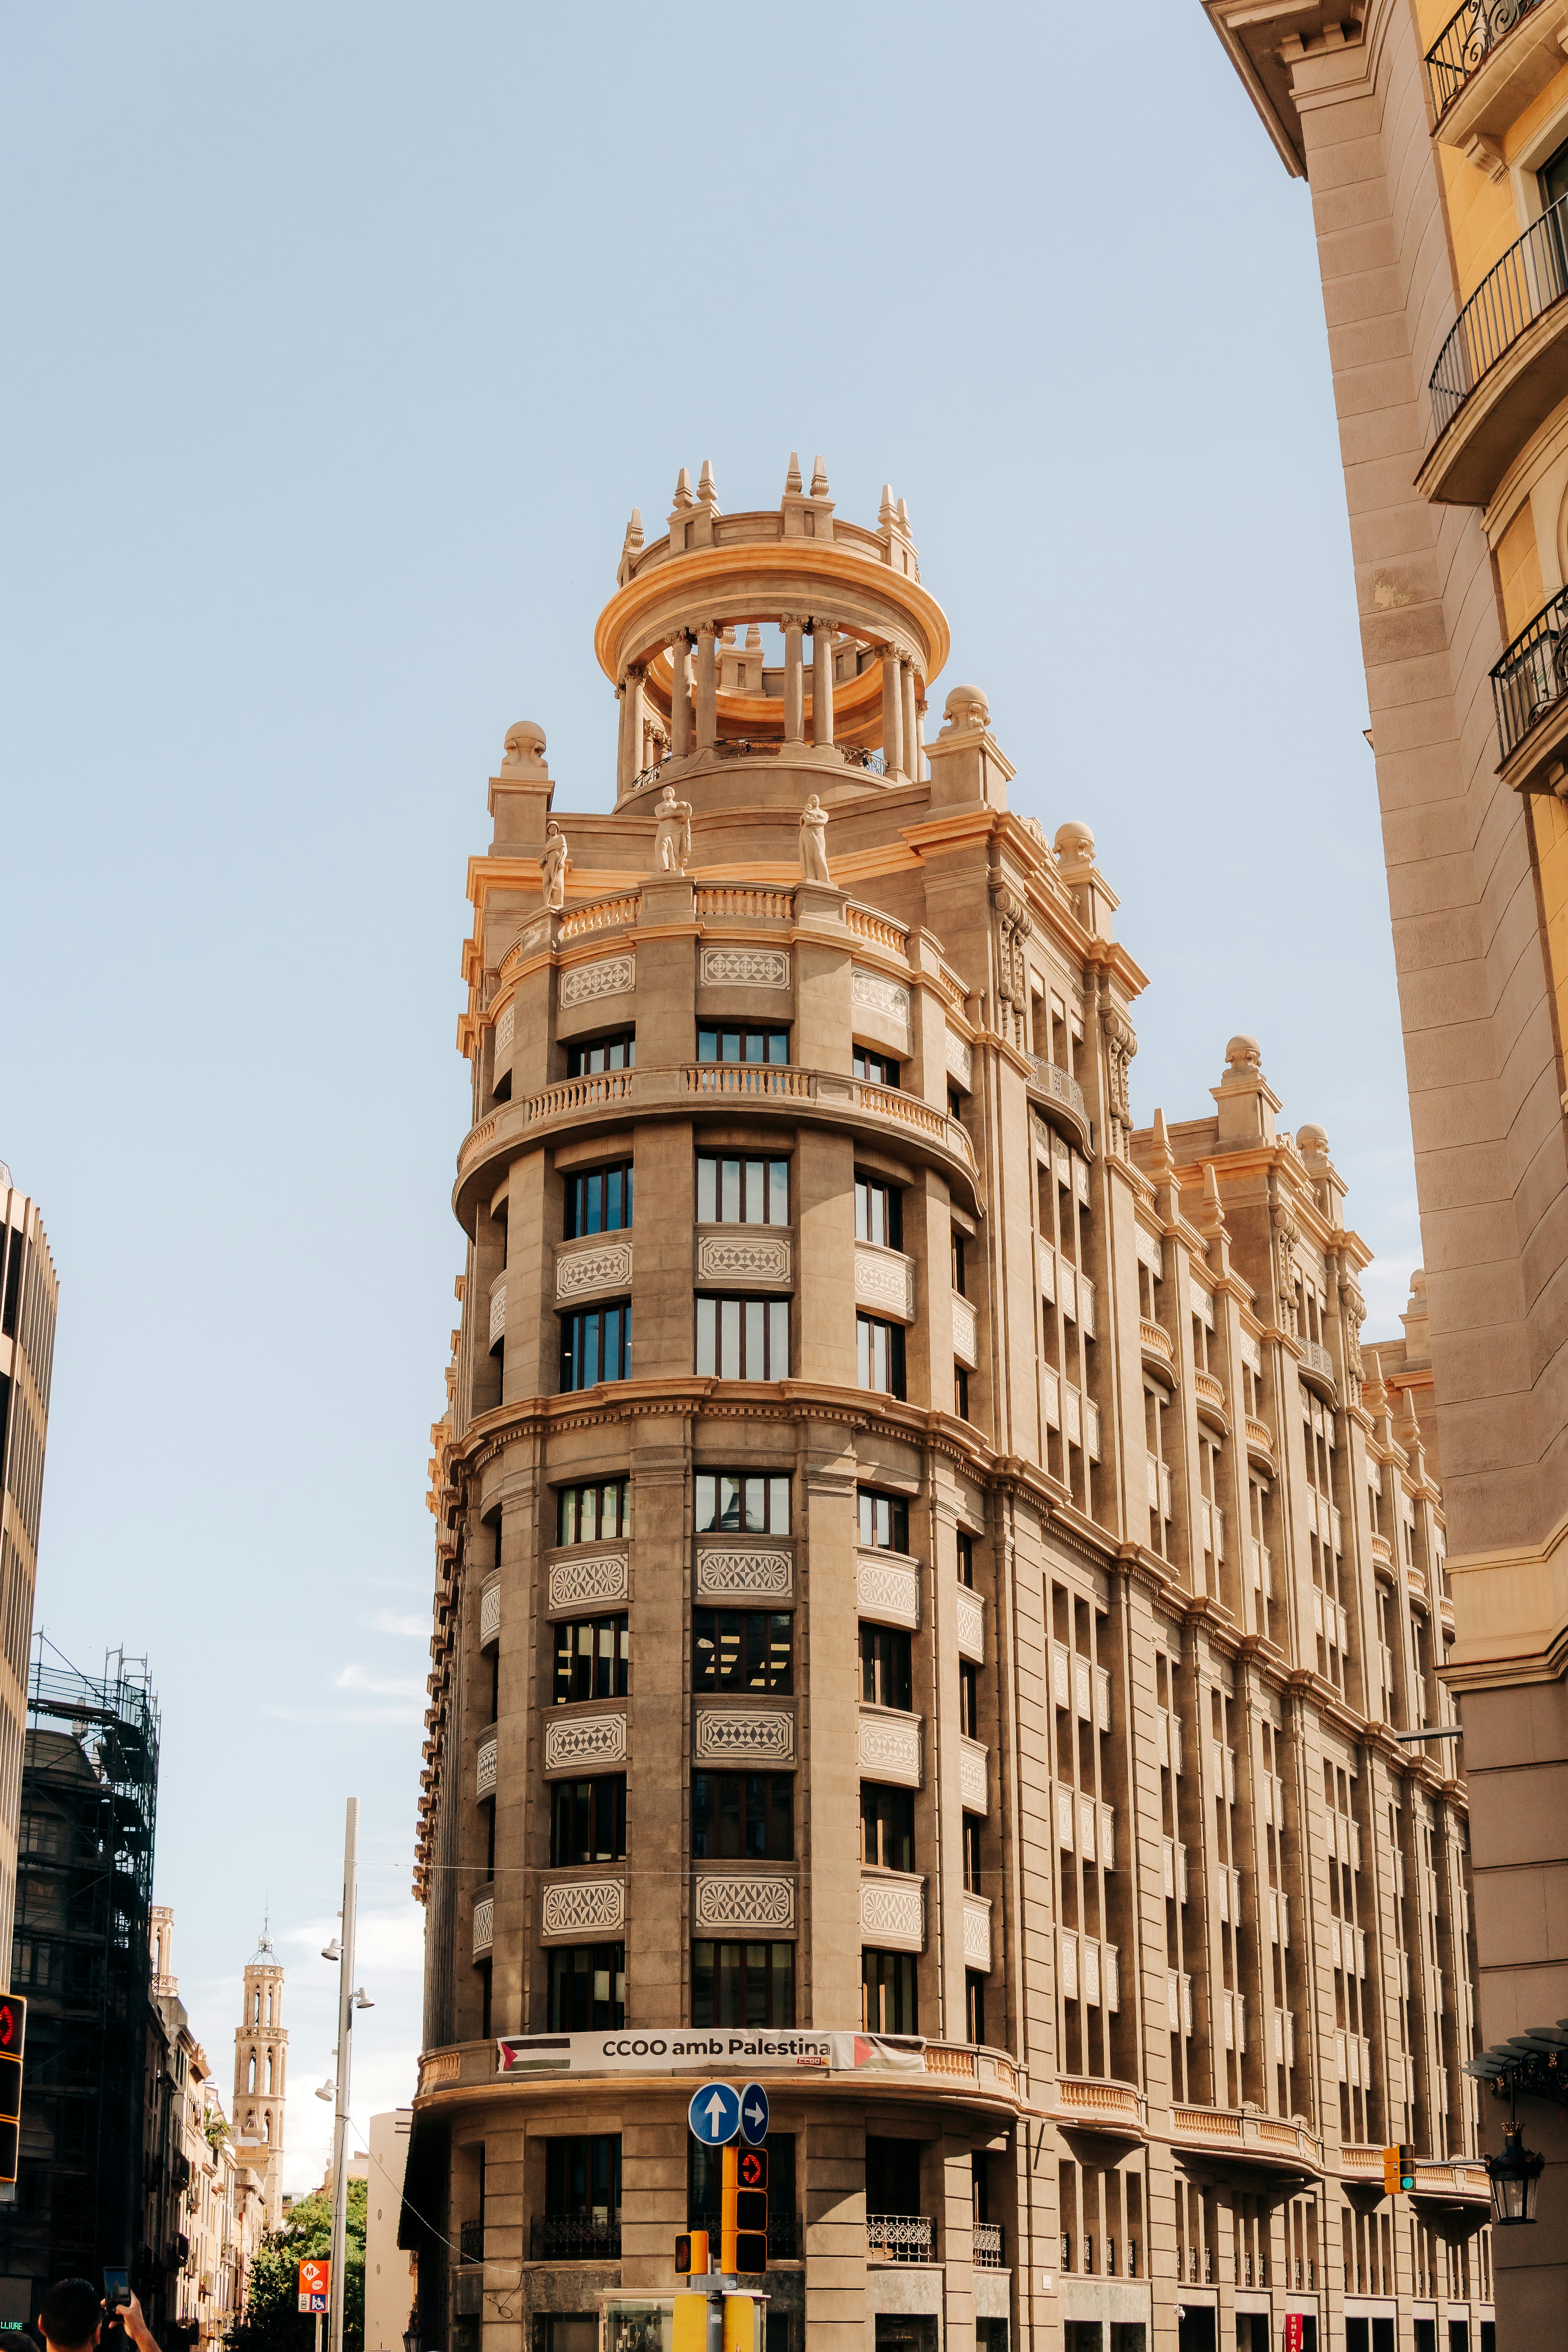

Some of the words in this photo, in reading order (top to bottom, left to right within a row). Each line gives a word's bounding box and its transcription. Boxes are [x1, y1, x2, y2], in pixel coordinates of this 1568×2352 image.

[603, 2040, 667, 2056] CCOO
[672, 2038, 724, 2055] amb
[729, 2037, 830, 2055] Palestina
[306, 2267, 313, 2276] M
[1, 2321, 23, 2330] LLIURE
